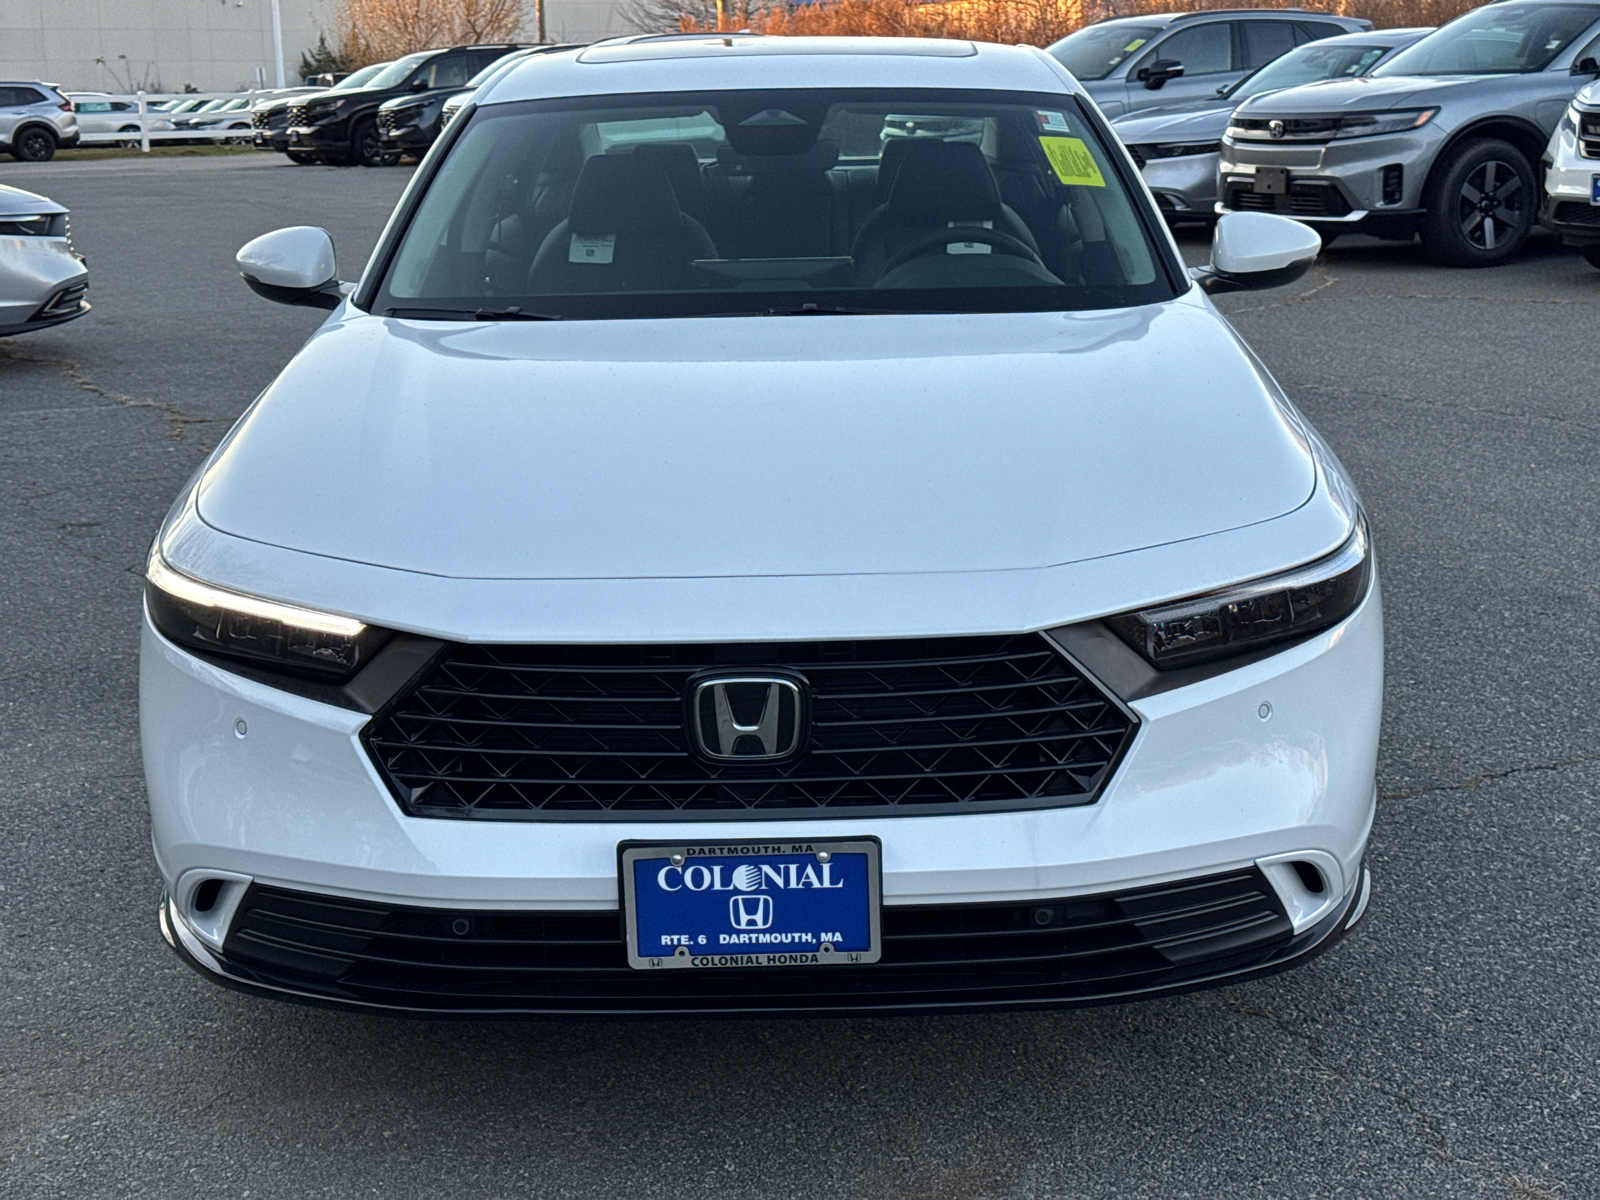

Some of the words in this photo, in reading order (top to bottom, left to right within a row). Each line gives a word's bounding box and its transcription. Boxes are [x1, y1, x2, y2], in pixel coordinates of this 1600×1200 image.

[791, 845, 814, 854] MA
[657, 863, 844, 891] COLONIAL
[661, 935, 694, 945] RTE.
[697, 935, 707, 945] 6
[719, 932, 817, 945] DARTMOUTH,
[820, 932, 843, 942] MA
[691, 955, 763, 967] COLONIAL
[767, 953, 819, 965] HONDA
